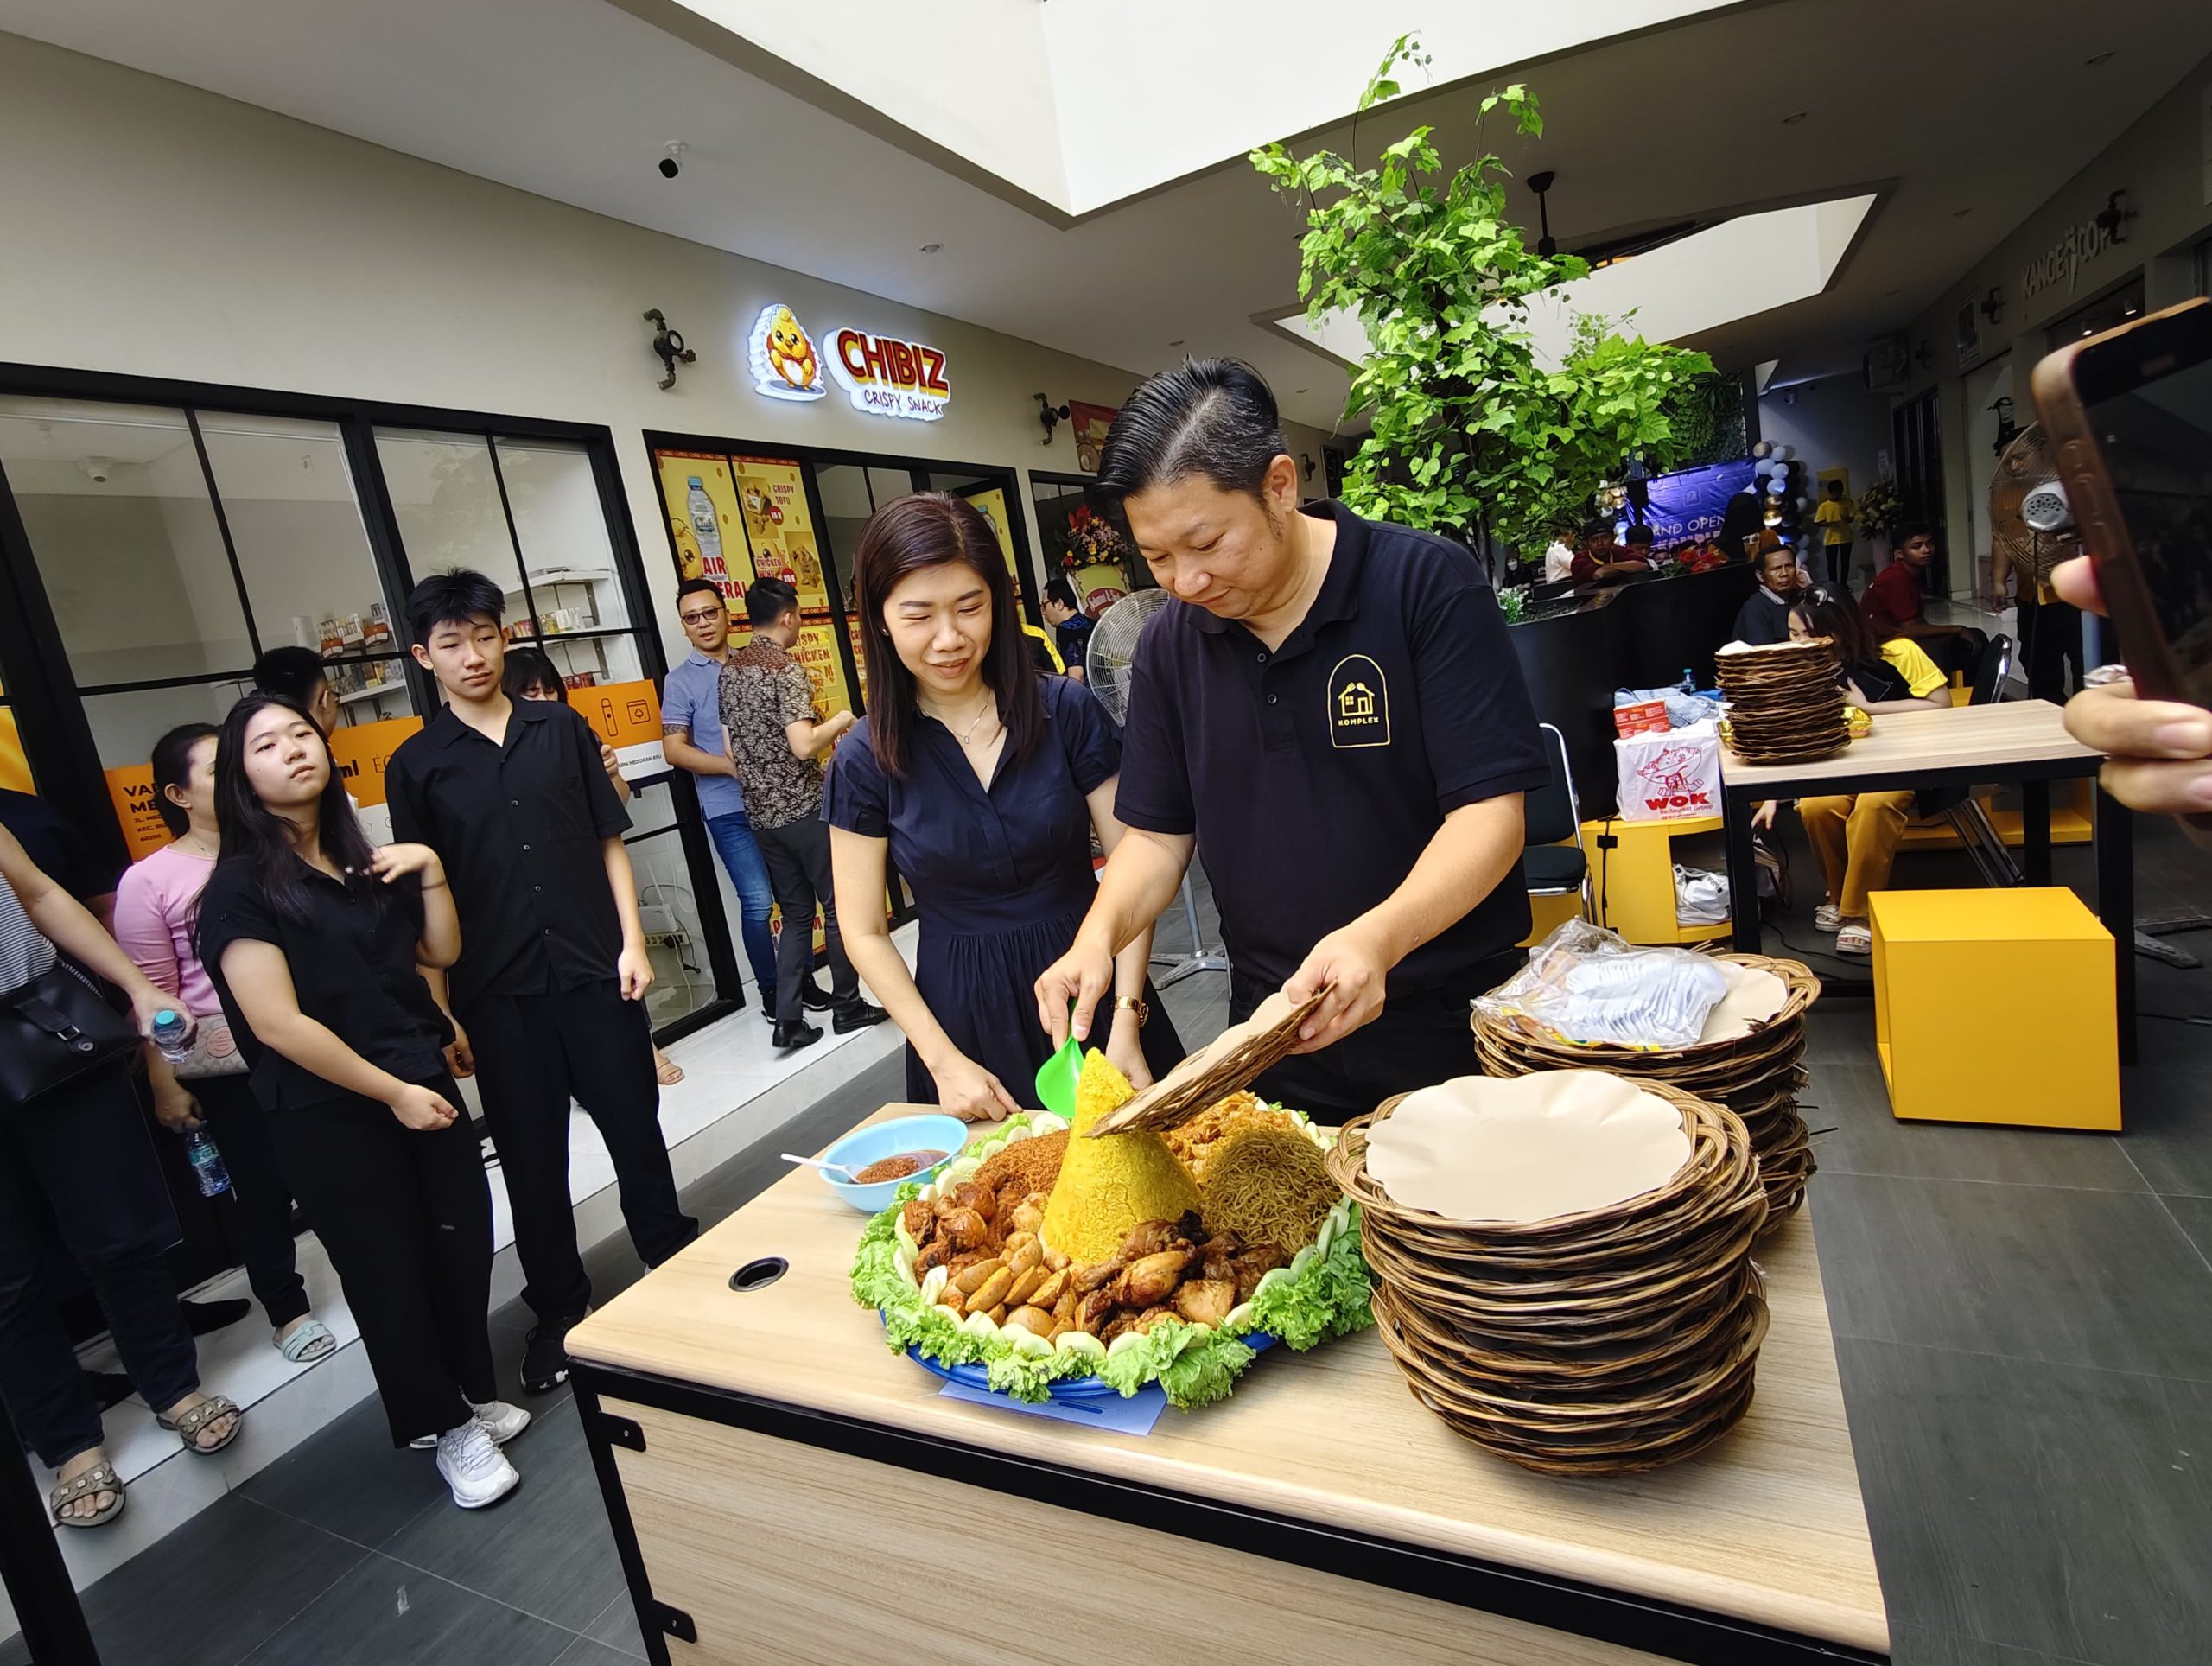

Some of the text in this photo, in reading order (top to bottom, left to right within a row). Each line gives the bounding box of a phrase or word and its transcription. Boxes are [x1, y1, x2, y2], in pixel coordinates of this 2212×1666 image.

[837, 330, 949, 394] CHIBIZ
[864, 389, 942, 415] CRISPY SNACK
[773, 485, 794, 493] CRISPY
[775, 496, 791, 505] TOFU
[703, 557, 727, 575] AIR
[1338, 716, 1379, 726] KOMPLEX
[1645, 792, 1710, 811] WOK
